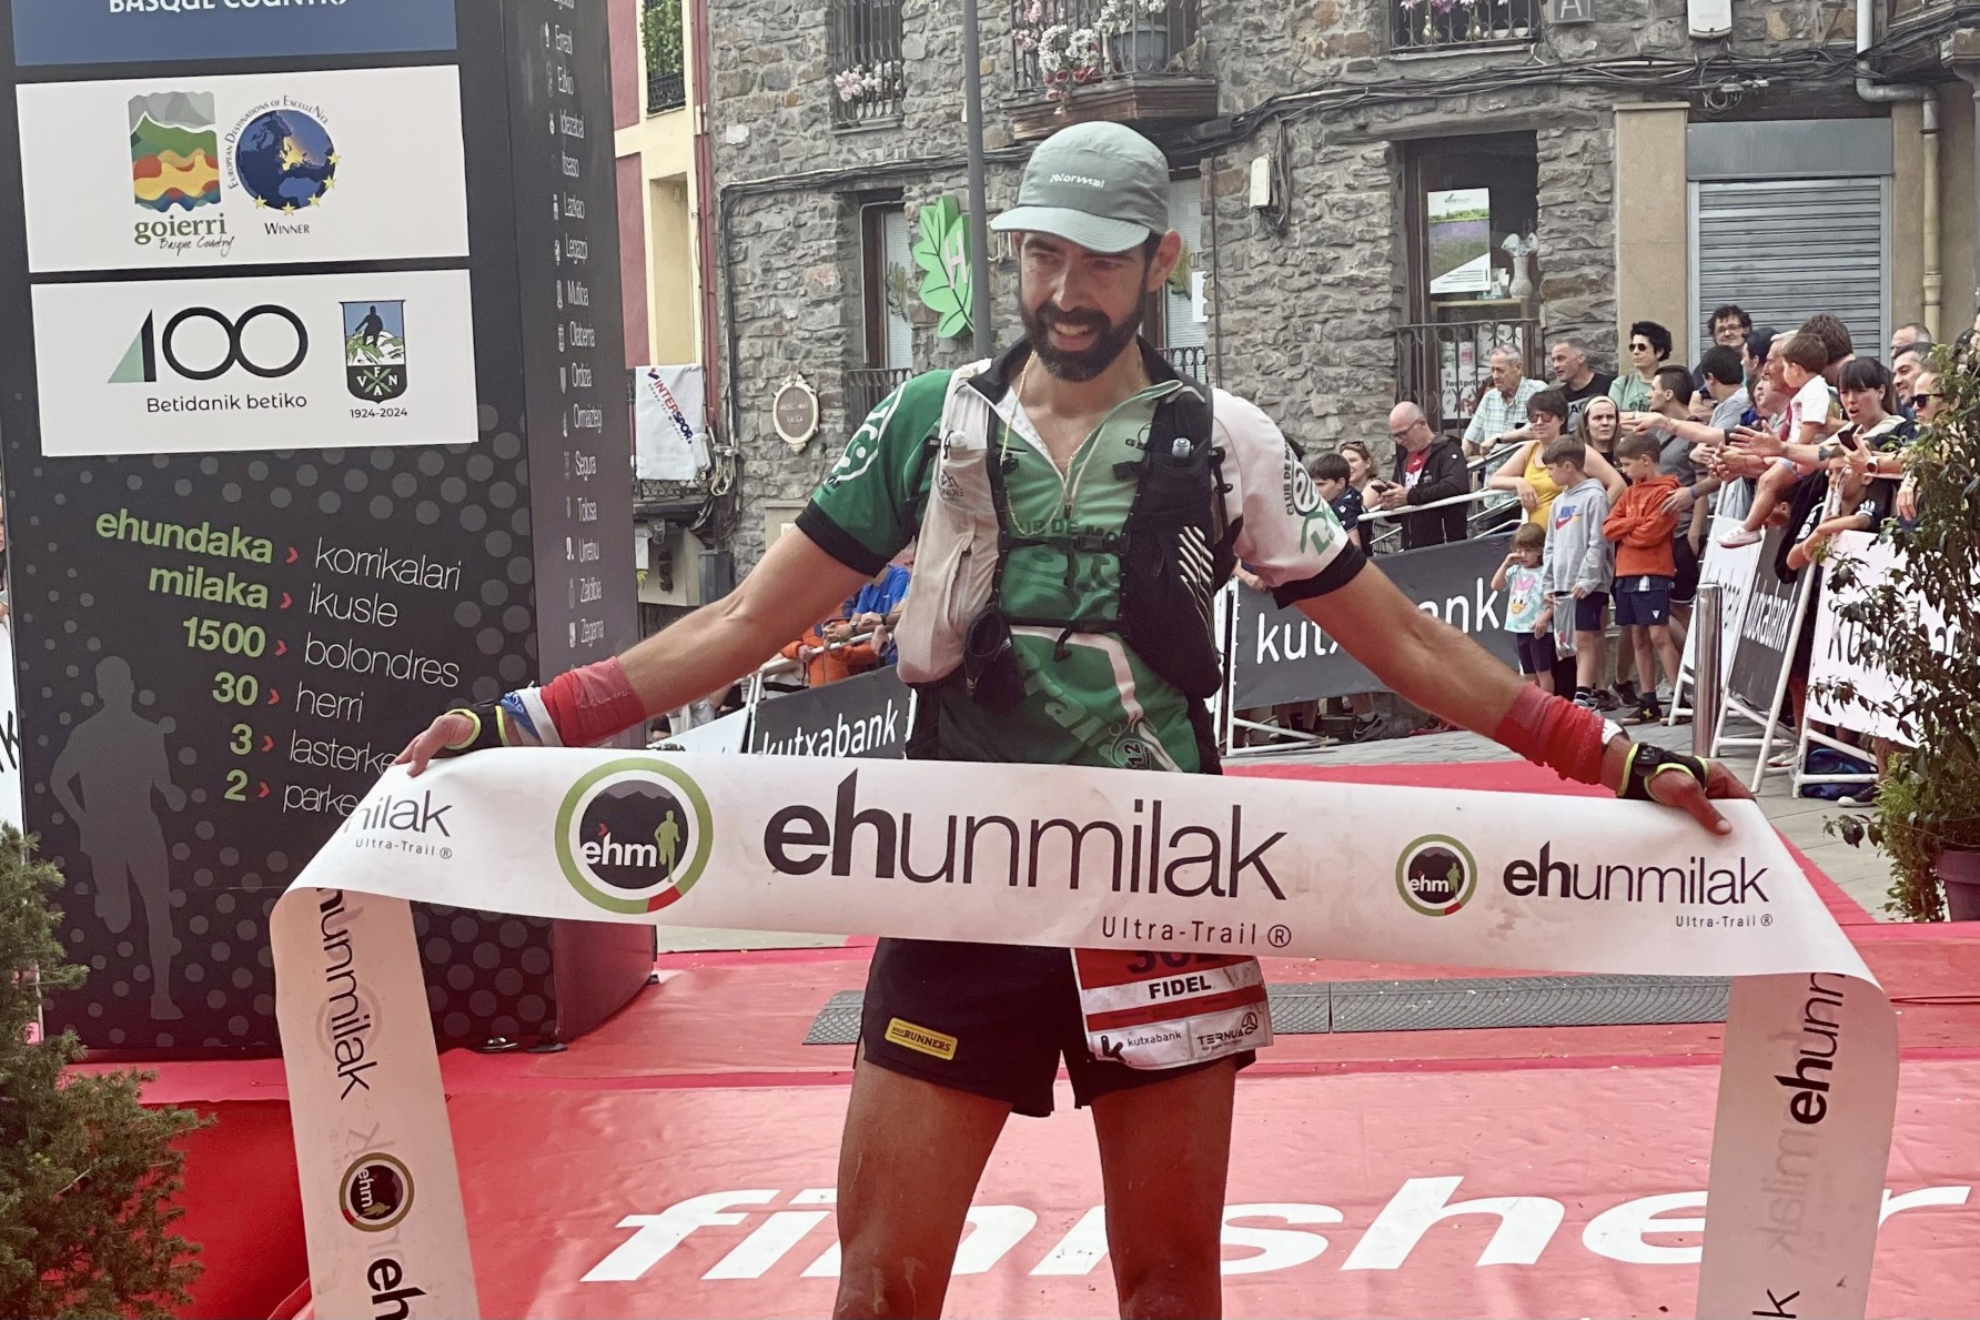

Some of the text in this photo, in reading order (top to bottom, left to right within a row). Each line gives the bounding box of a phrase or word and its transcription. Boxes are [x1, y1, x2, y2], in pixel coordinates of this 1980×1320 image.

[134, 213, 227, 245] goierri
[159, 237, 192, 256] Basque
[147, 393, 308, 413] Betidanik betiko
[350, 408, 408, 419] 1924-2024
[653, 379, 694, 445] INTERSPOR
[95, 508, 462, 592] ehundaka korrikalari
[148, 564, 398, 627] milaka ikusle
[182, 615, 461, 688] 1500 bolondres
[212, 671, 364, 723] 30 herri
[229, 724, 254, 755] 3
[761, 698, 900, 757] kutxabank
[224, 769, 249, 801] 2
[355, 838, 436, 857] Ultra-Trail
[580, 828, 657, 868] ehm
[763, 766, 1288, 901] ehunmilak
[1409, 873, 1450, 894] ehm
[1503, 840, 1769, 905] ehunmilak
[1101, 914, 1258, 946] Ultra-Trail
[1676, 914, 1757, 929] Ultra-Trail
[1148, 975, 1212, 1000] FIDEL
[903, 1029, 952, 1052] RUNNERS
[1127, 1030, 1183, 1047] kutxabank
[1197, 1028, 1245, 1046] TERNUA
[357, 1168, 374, 1208] ehm
